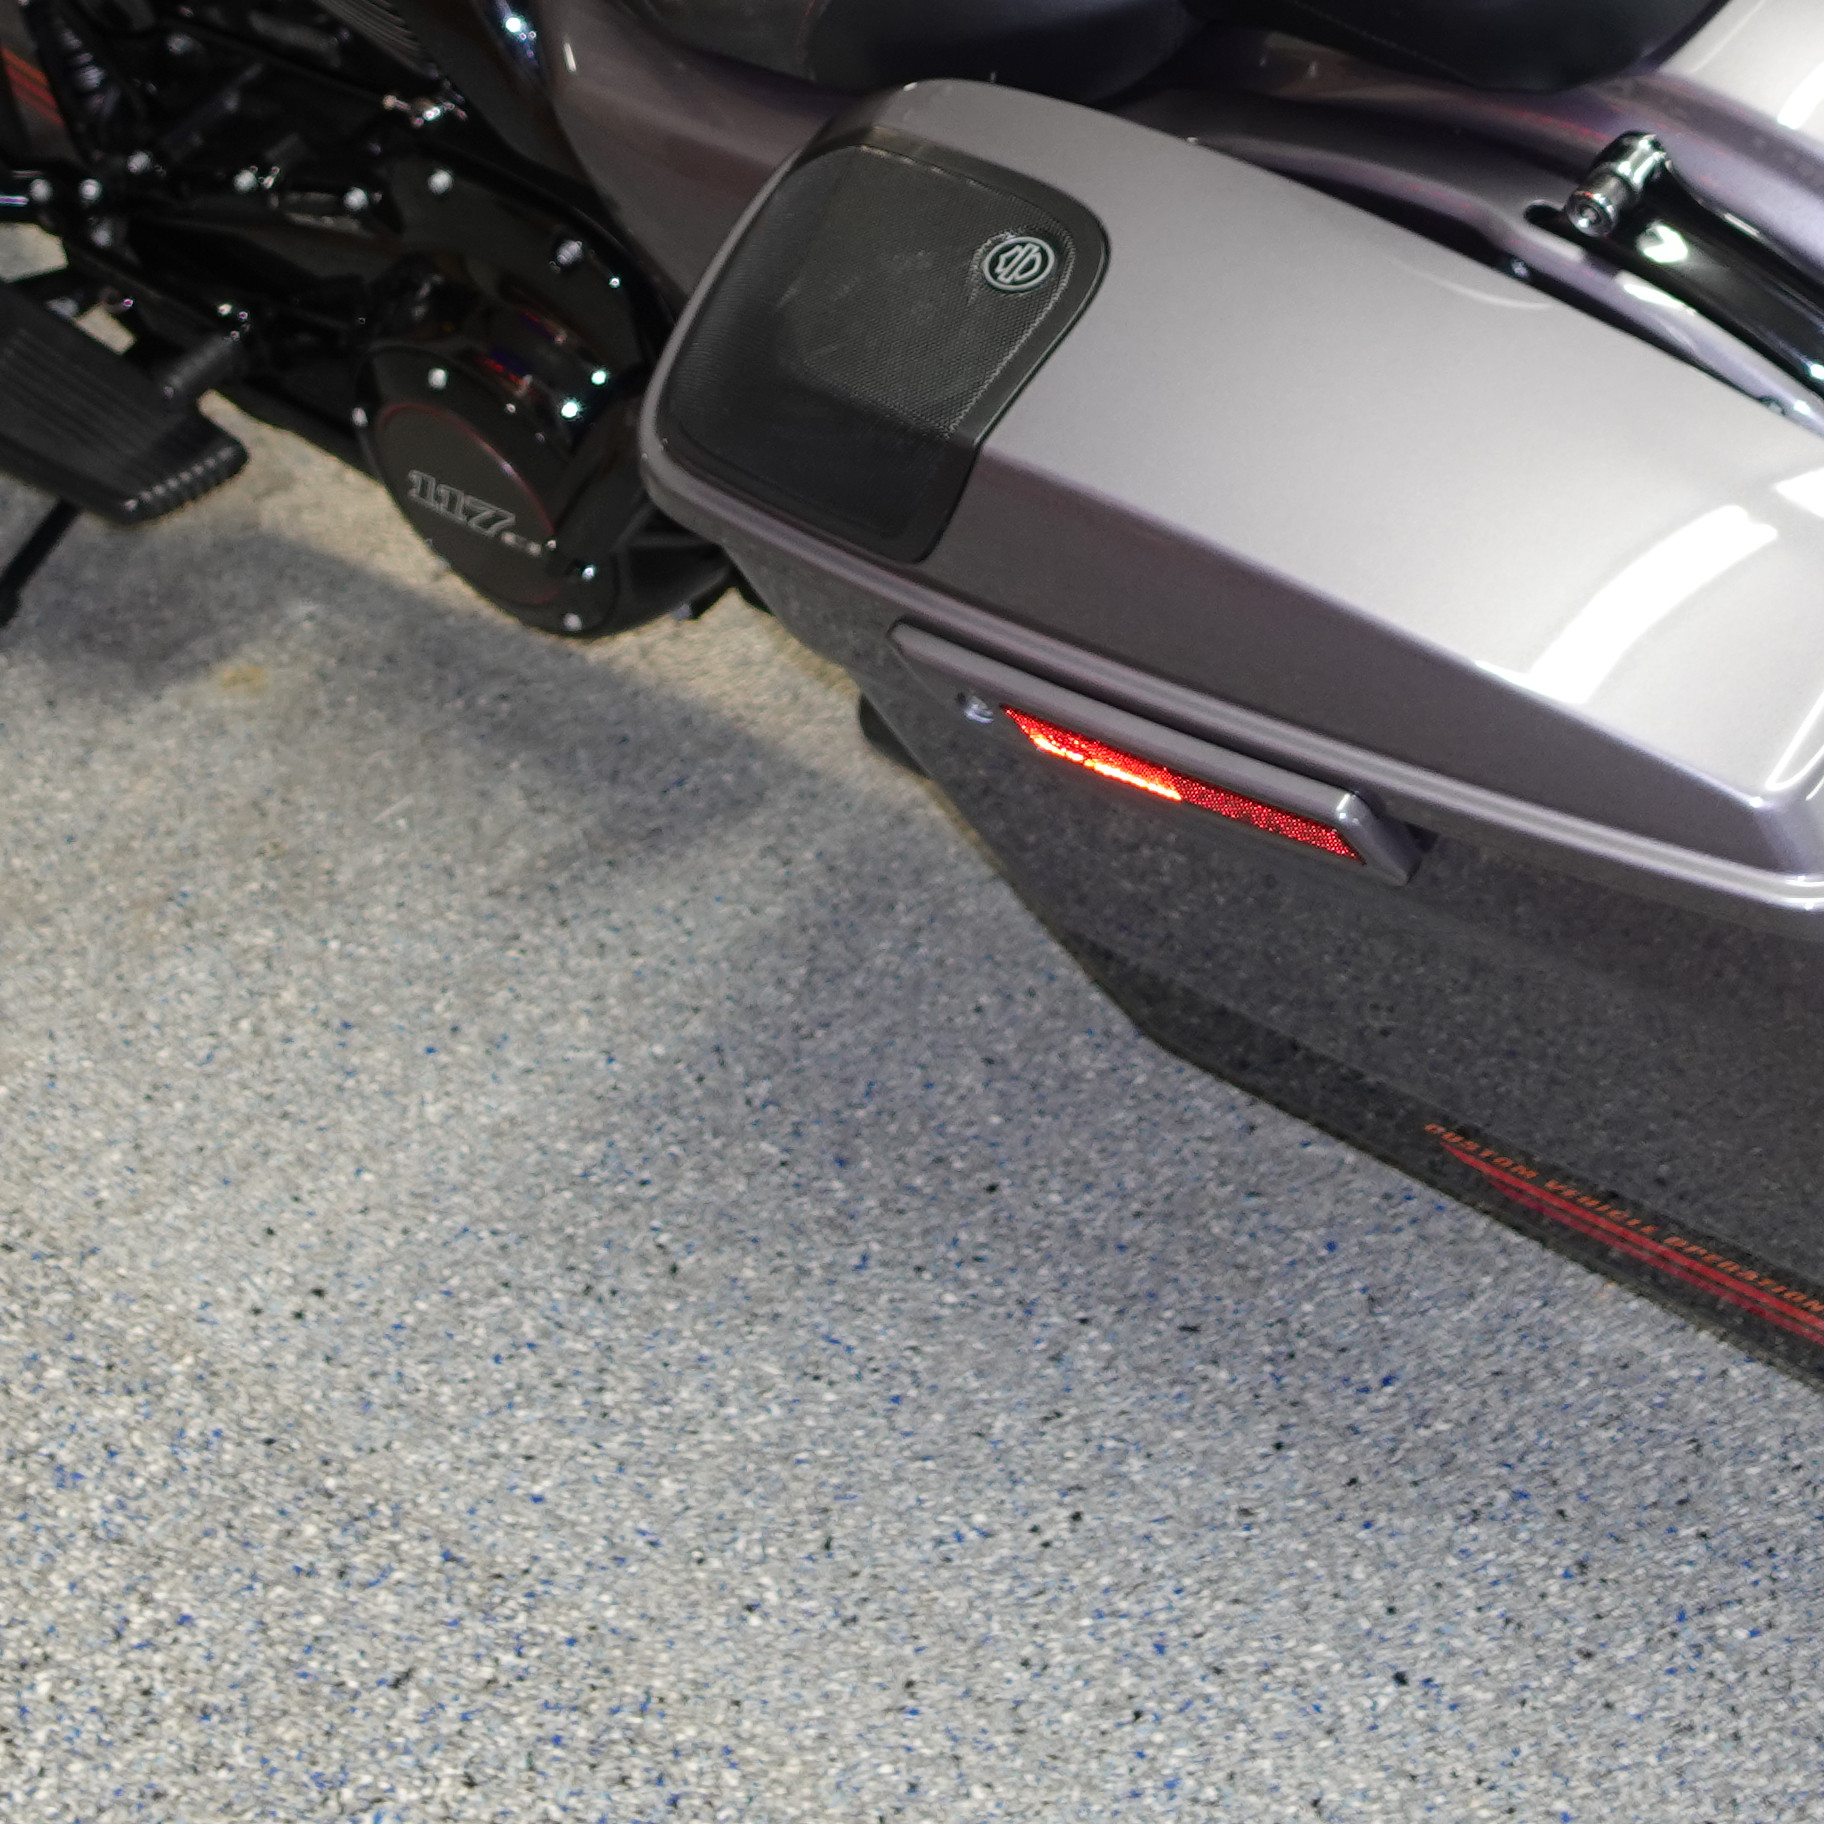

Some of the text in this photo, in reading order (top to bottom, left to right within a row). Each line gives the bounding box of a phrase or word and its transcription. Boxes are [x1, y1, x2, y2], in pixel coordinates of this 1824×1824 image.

[407, 469, 516, 536] 117
[1424, 1123, 1539, 1179] CUSTOM
[1544, 1179, 1658, 1235] VEHICLE
